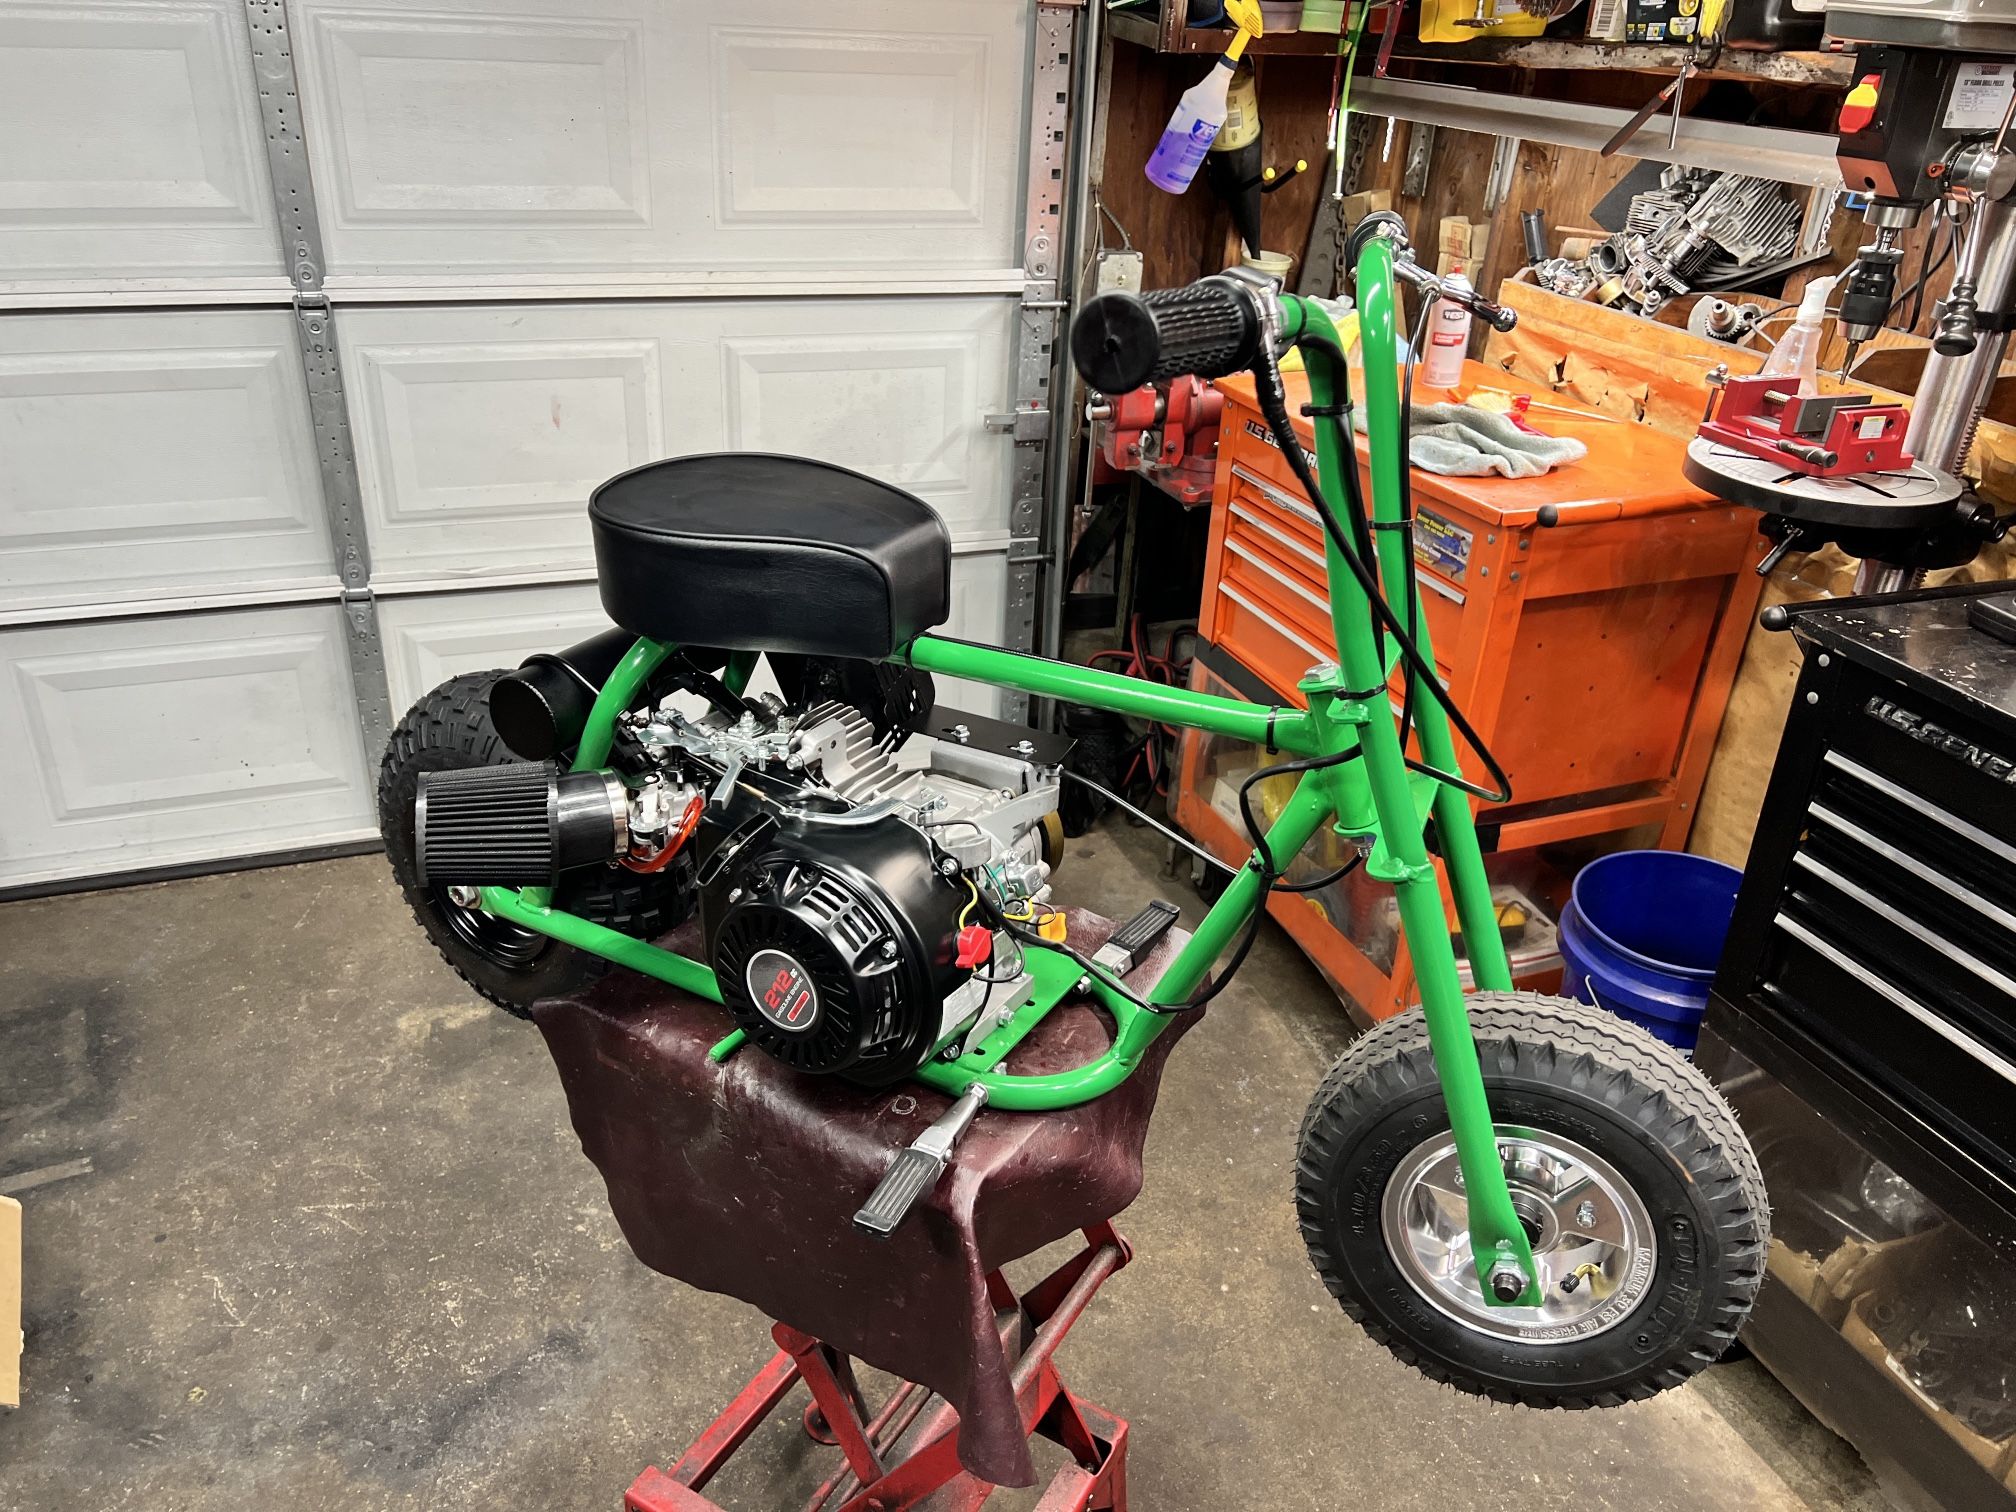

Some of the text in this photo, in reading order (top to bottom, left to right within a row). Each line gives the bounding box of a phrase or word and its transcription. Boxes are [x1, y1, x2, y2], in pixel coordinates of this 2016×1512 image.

[764, 969, 793, 1009] 212
[775, 992, 793, 1019] GASOLINE
[790, 975, 804, 996] ENGINE
[1577, 1317, 1600, 1334] AIR
